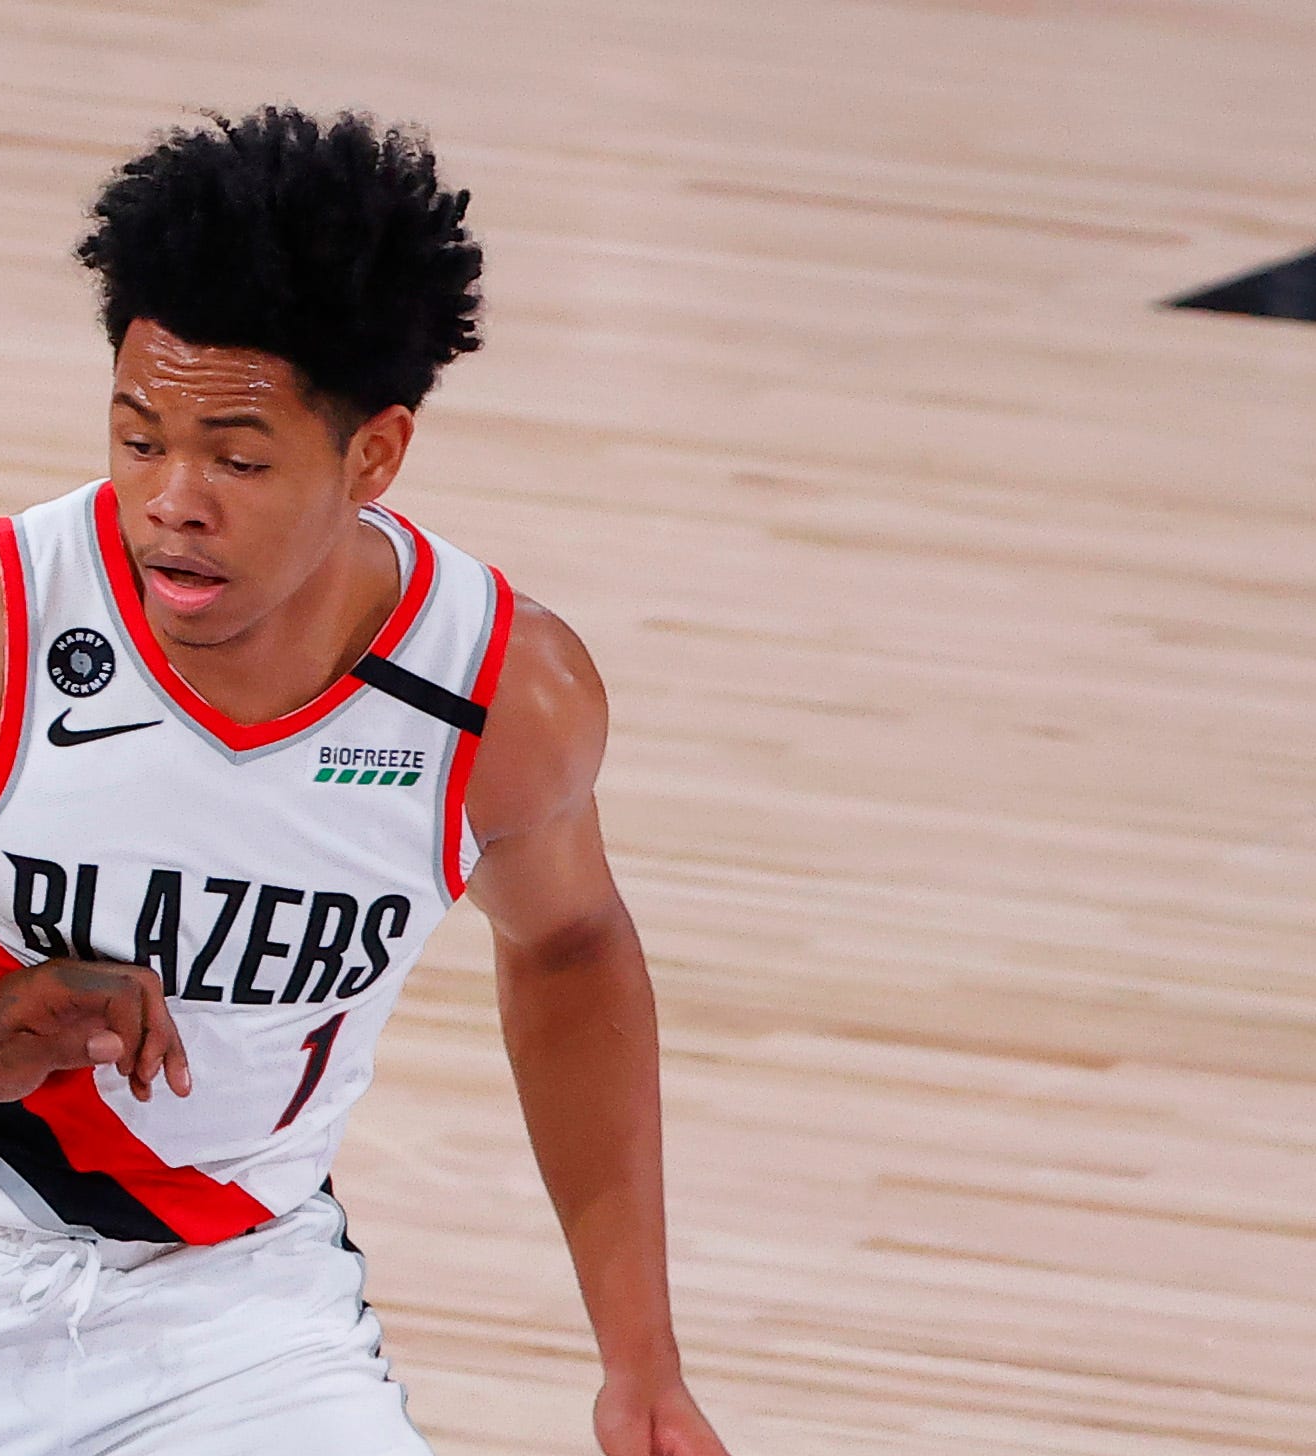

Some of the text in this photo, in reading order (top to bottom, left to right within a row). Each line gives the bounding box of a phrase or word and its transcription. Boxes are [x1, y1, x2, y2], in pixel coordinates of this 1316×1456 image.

[51, 662, 113, 694] GLICKMAN
[55, 632, 104, 651] HARRY
[2, 851, 412, 1005] BLAZERS
[270, 1011, 349, 1136] 1
